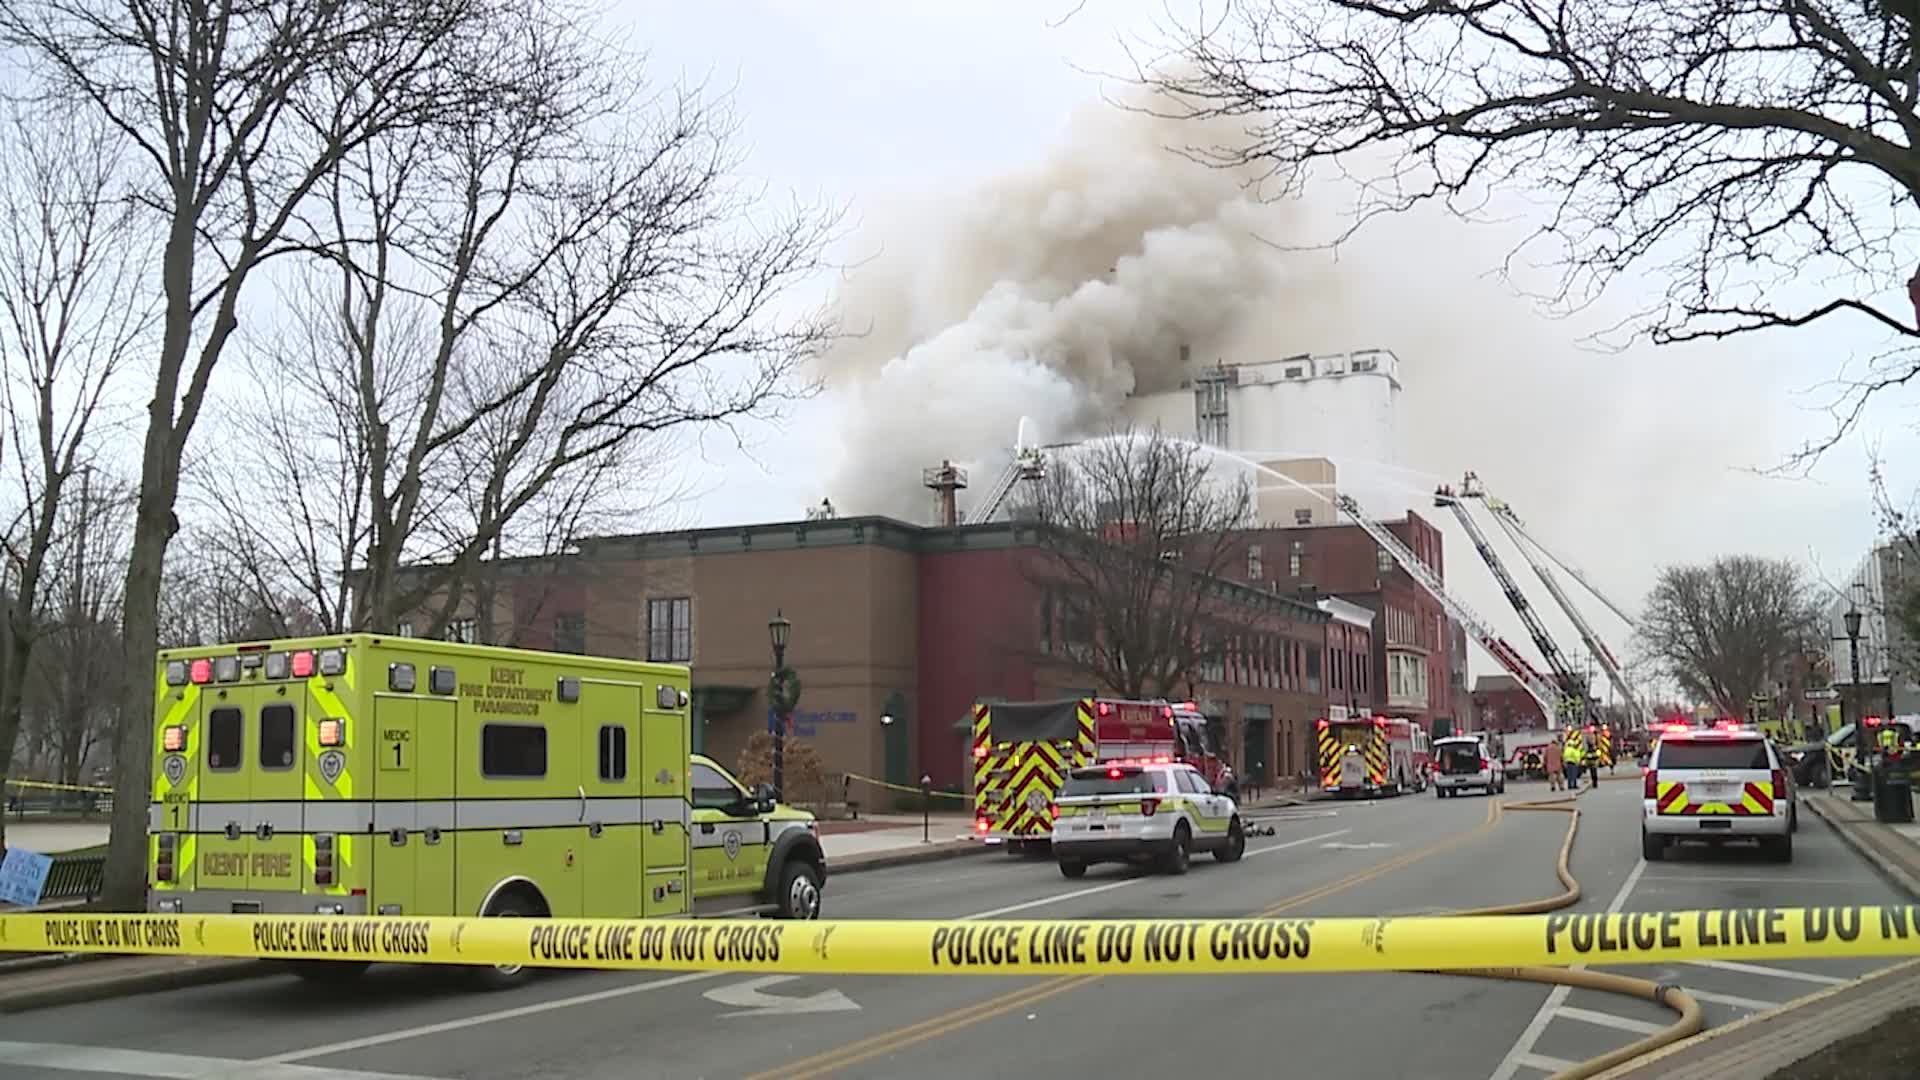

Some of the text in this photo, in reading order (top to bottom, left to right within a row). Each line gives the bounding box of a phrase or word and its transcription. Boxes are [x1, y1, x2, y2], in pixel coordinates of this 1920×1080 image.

[490, 666, 525, 685] KENT
[460, 683, 552, 702] FIRE DEPARTMENT
[383, 729, 410, 742] MEDIC
[392, 743, 401, 768] 1
[163, 792, 187, 804] MEDIC
[171, 805, 179, 828] 1
[203, 852, 292, 877] KENT FIRE
[45, 919, 181, 947] POLICE LINE DO NOT CROSS
[253, 921, 430, 954] POLICE LINE DO NOT CROSS
[931, 918, 1316, 965] POLICE LINE DO NOT CROSS
[1546, 911, 1682, 953] POLICE
[1697, 909, 1787, 947] LINE
[1803, 905, 1861, 942] DO
[529, 925, 784, 962] POLICE LINE DO NOT CROSS
